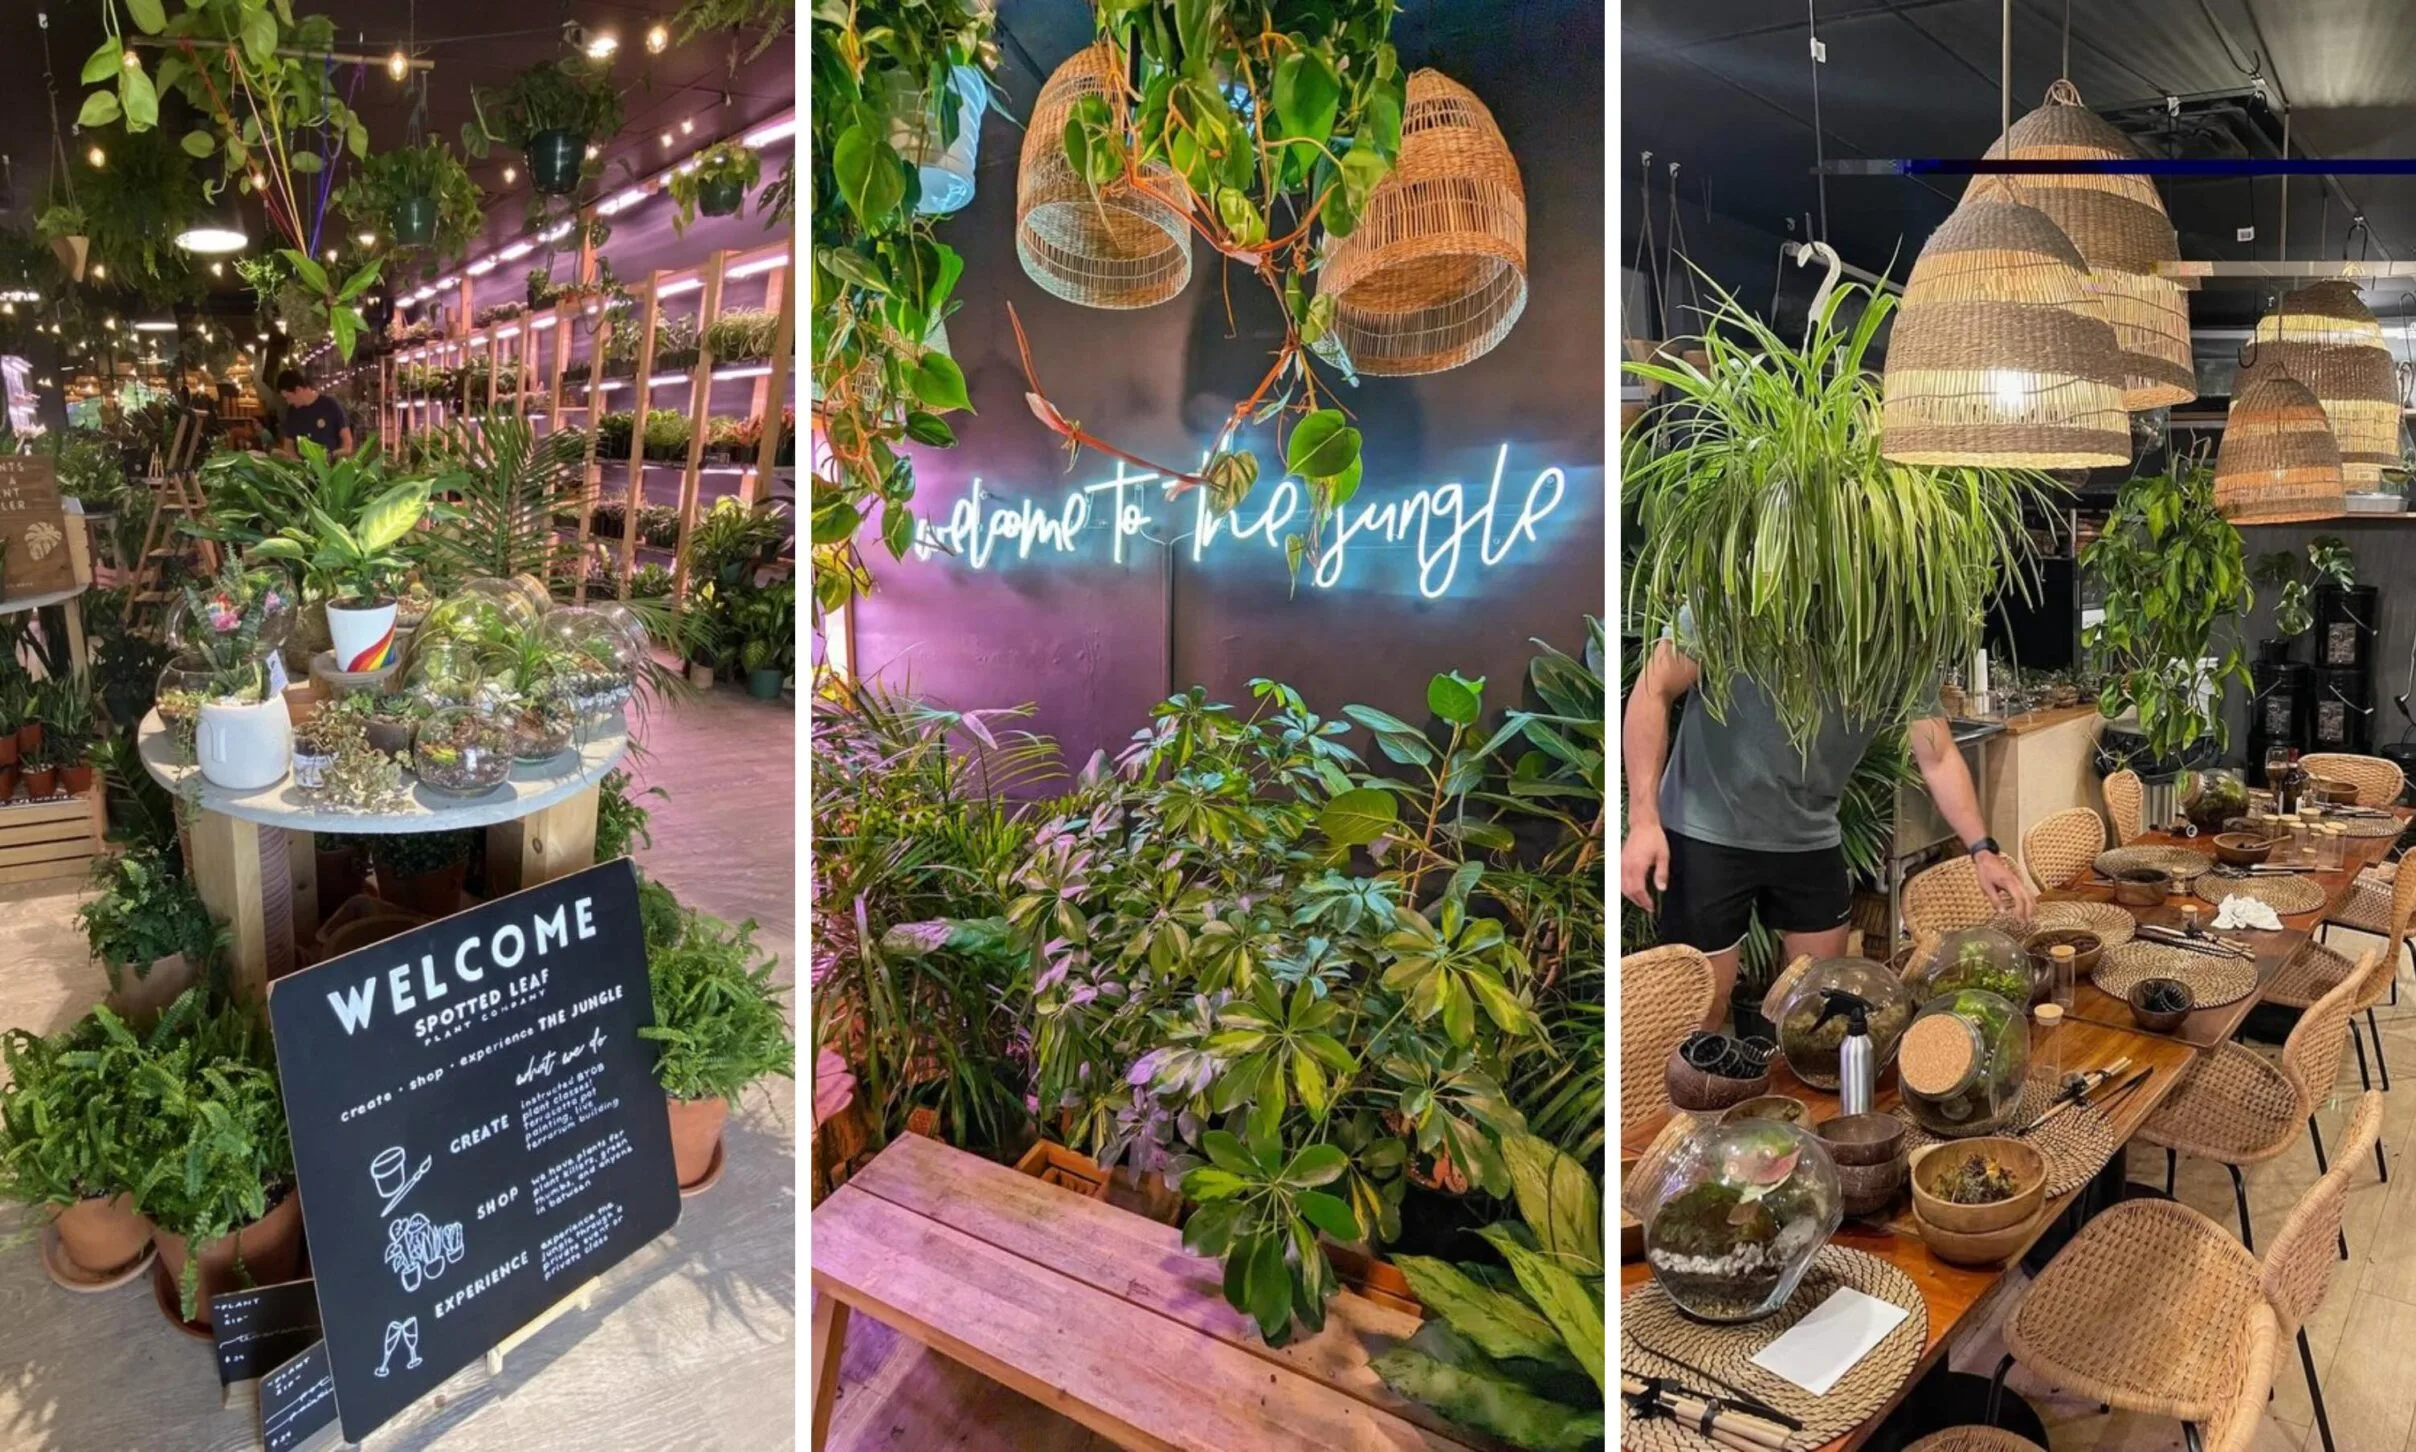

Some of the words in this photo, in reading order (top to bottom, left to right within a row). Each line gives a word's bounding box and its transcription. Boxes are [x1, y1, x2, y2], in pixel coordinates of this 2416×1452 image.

[913, 476, 1086, 569] welcome
[1314, 443, 1565, 598] jungle
[327, 896, 597, 1036] WELCOME
[414, 988, 501, 1038] SPOTTED
[509, 967, 550, 998] LEAF
[424, 1020, 472, 1047] PLANT
[481, 988, 546, 1022] COMPANY
[340, 1092, 393, 1123] create
[409, 1067, 444, 1091] shop
[459, 1027, 534, 1066] experience
[537, 1008, 567, 1032] THE
[570, 985, 624, 1019] JUNGLE
[515, 1050, 557, 1086] what
[562, 1042, 585, 1065] we
[589, 1026, 608, 1054] do
[521, 1076, 575, 1109] instructed
[577, 1062, 605, 1082] BYOB
[522, 1100, 550, 1122] plant
[523, 1098, 578, 1130] terracotta
[580, 1087, 597, 1104] pot
[575, 1100, 594, 1115] live
[450, 1113, 510, 1154] CREATE
[526, 1121, 576, 1151] terrarium
[578, 1098, 620, 1123] building
[531, 1173, 546, 1186] we
[548, 1158, 575, 1176] have
[576, 1139, 606, 1162] plants
[609, 1129, 624, 1143] for
[533, 1175, 560, 1198] plant
[601, 1138, 628, 1161] green
[578, 1165, 596, 1180] and
[599, 1146, 633, 1168] anyone
[476, 1186, 519, 1220] SHOP
[536, 1206, 546, 1216] in
[548, 1179, 592, 1208] between
[541, 1213, 596, 1250] experience
[598, 1202, 614, 1215] the
[542, 1237, 574, 1262] jungle
[576, 1211, 614, 1239] through
[616, 1204, 623, 1214] a
[543, 1242, 580, 1272] private
[583, 1223, 609, 1245] event
[613, 1214, 623, 1226] or
[434, 1250, 529, 1319] EXPERIENCE
[544, 1252, 581, 1282] private
[584, 1234, 609, 1254] class
